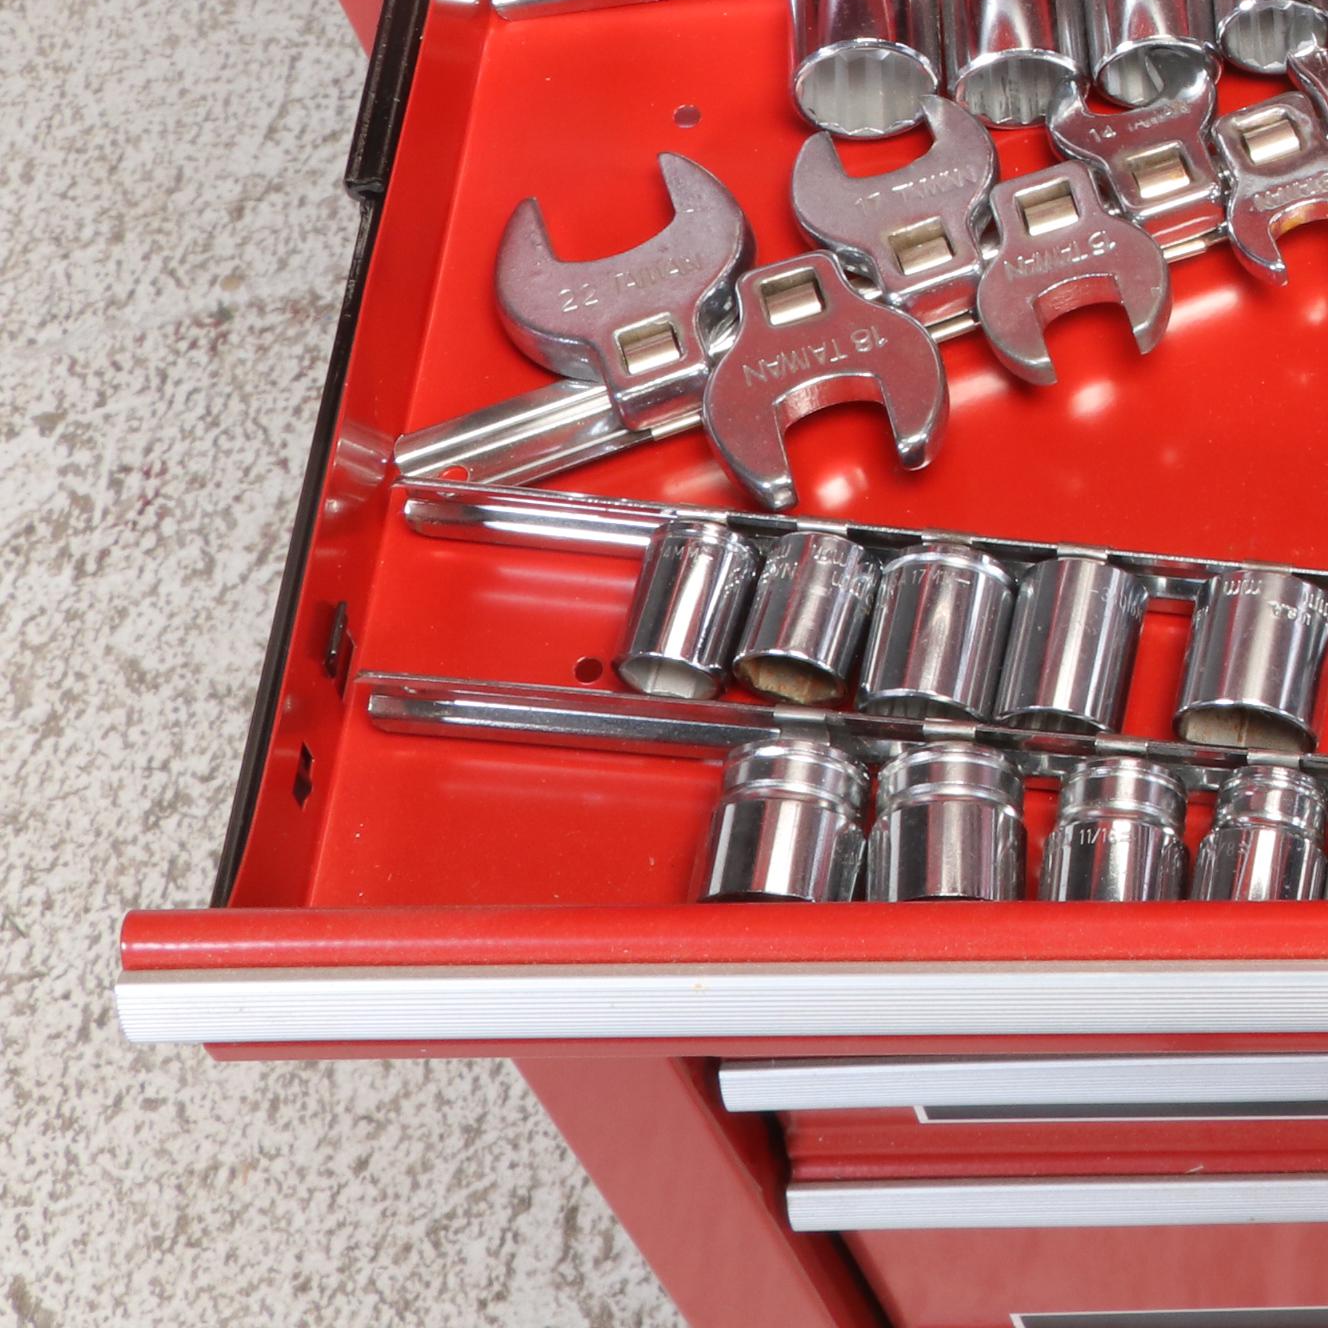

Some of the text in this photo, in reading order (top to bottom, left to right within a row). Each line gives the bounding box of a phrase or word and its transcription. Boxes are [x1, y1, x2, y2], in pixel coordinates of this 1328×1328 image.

[558, 283, 599, 313] 22
[742, 324, 889, 387] 18 TAIWAN
